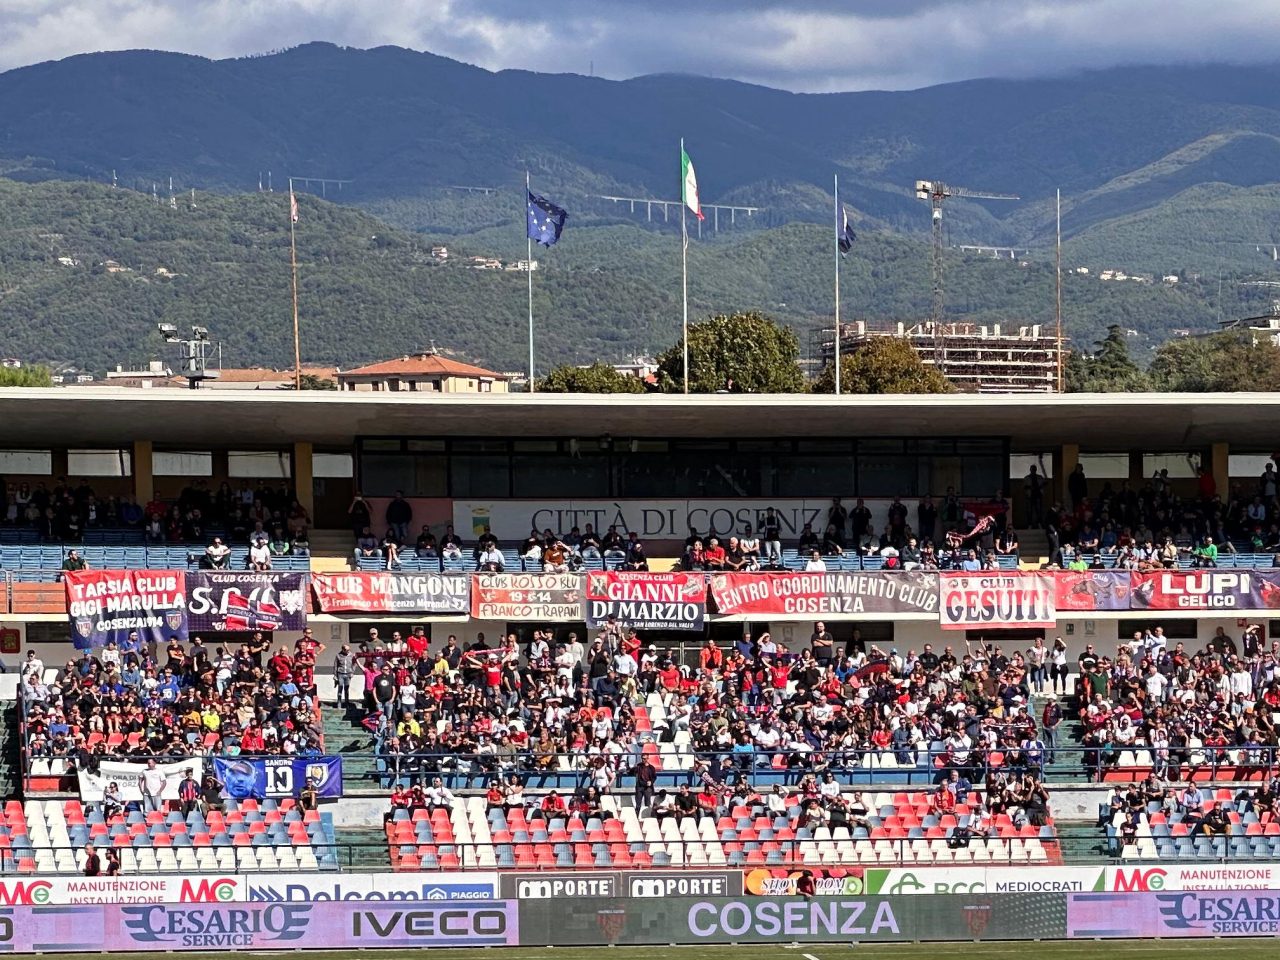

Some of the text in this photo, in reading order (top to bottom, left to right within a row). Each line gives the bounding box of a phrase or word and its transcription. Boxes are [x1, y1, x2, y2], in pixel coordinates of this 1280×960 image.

[531, 503, 822, 535] CITTÀ DI COSENZ
[212, 575, 279, 583] CLUB COSENZA
[314, 576, 467, 595] CLUB MANGONE
[481, 575, 579, 589] CLUB ROSSO BLU
[980, 578, 1015, 589] CLUB
[1161, 574, 1250, 594] LUPI
[73, 577, 177, 599] TARSIA CLUB
[607, 583, 684, 602] GIANNI
[717, 575, 937, 613] CENTRO COORDINAMENTO CLUB
[70, 600, 103, 617] GIGI
[107, 592, 185, 612] MARULLA
[481, 604, 580, 617] FRANCO TRAPANI
[592, 601, 699, 620] DI MARZIO
[784, 596, 864, 613] COSENZA
[946, 590, 1052, 622] GESUITI
[1180, 869, 1271, 880] MANUTENZIONE
[67, 880, 167, 892] MANUTENZIONE
[553, 879, 609, 895] PORTE
[666, 878, 722, 895] PORTE
[995, 881, 1083, 892] MEDIOCRATI
[353, 910, 507, 937] IVECO
[687, 901, 900, 936] COSENZA
[1212, 921, 1279, 933] SERVICE
[182, 934, 254, 947] SERVICE
